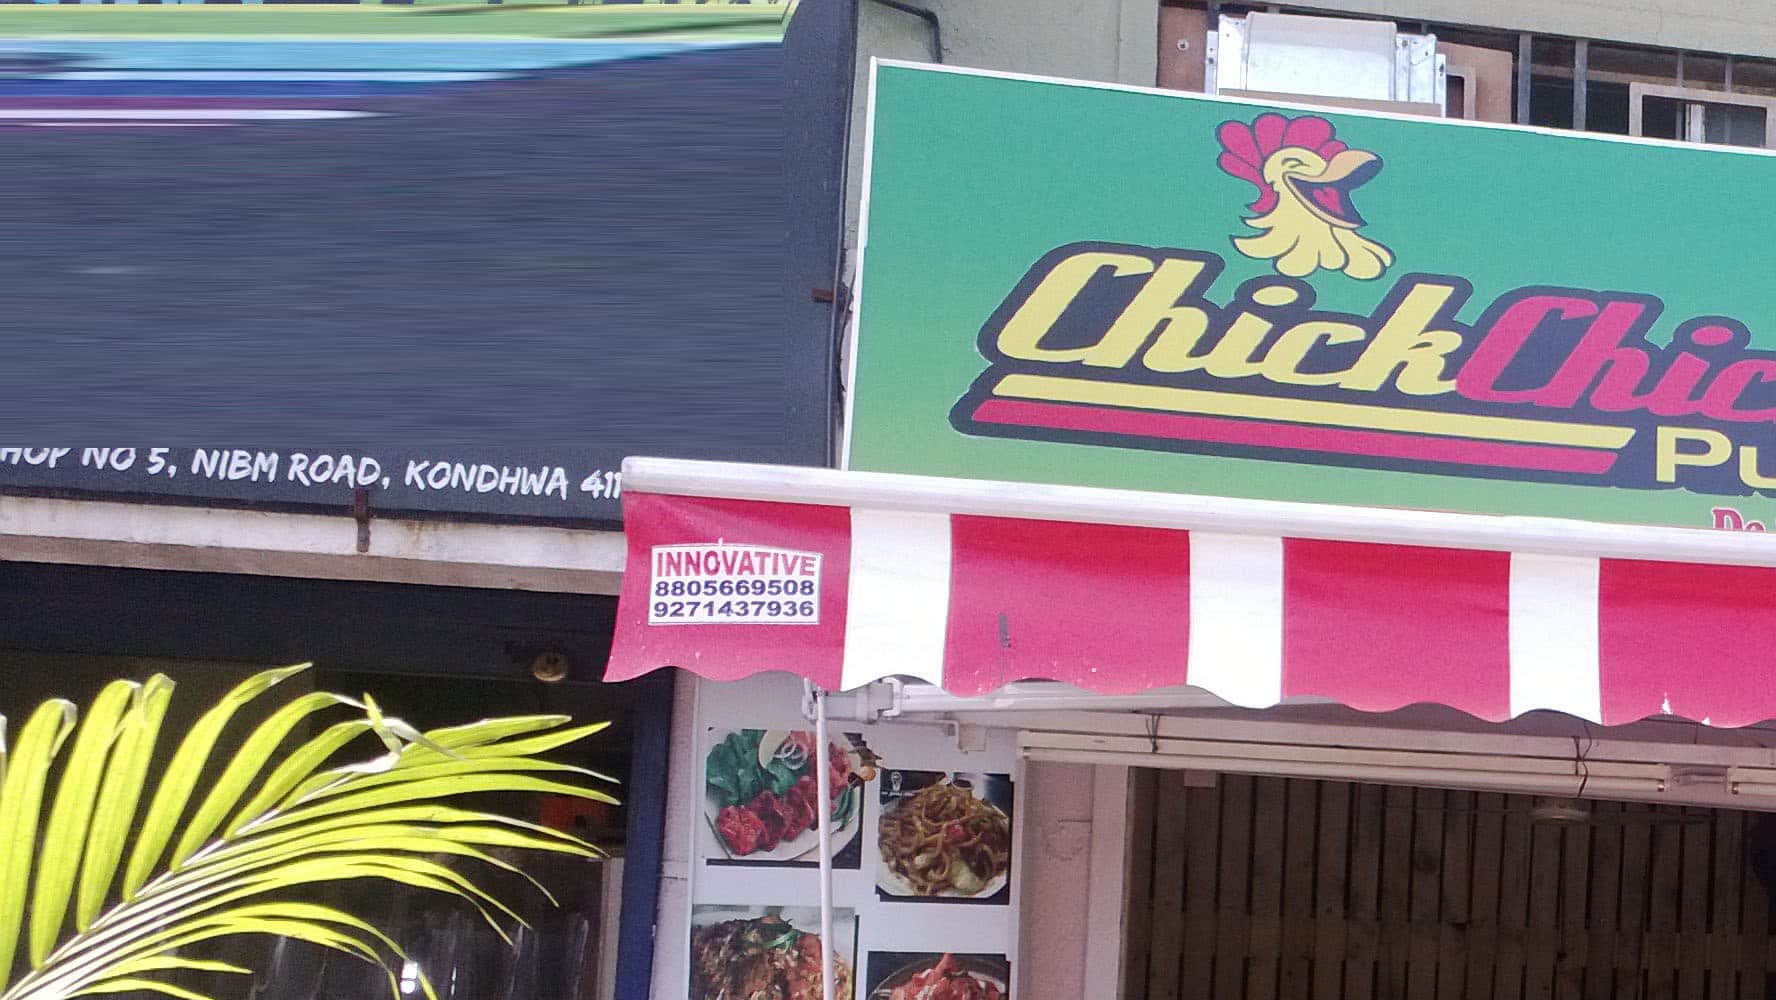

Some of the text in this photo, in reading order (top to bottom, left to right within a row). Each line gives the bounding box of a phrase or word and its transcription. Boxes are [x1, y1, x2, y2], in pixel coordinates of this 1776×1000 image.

[81, 448, 136, 471] NO
[190, 448, 280, 482] NIBM
[287, 453, 390, 490] ROAD,
[404, 459, 569, 500] KONDHWA
[656, 550, 817, 577] INNOVATIVE
[655, 580, 815, 596] 8805669508
[654, 601, 814, 617] 9271437936
